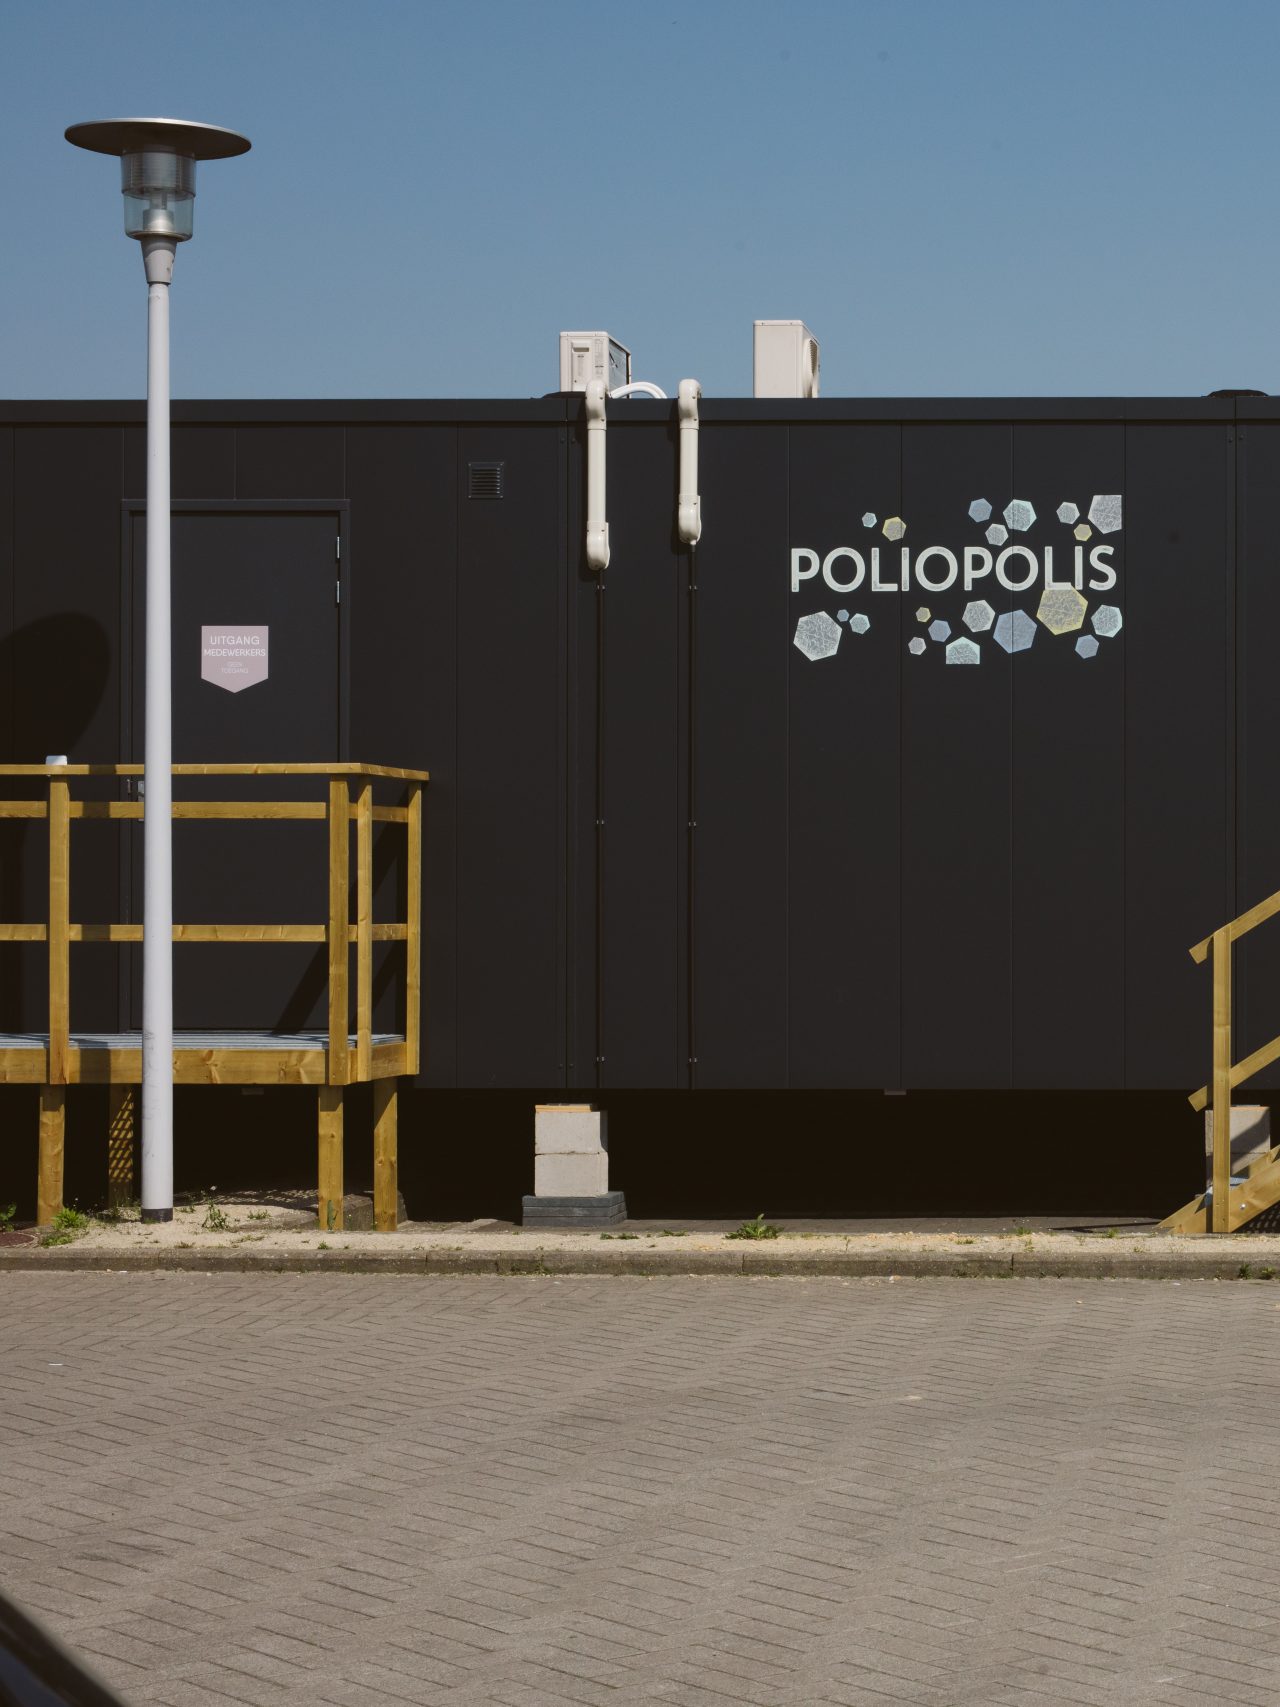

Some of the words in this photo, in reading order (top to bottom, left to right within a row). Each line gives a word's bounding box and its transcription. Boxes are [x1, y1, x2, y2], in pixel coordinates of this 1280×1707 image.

[791, 545, 1117, 593] POLIOPOLIS
[210, 635, 260, 645] UITGANG
[204, 648, 266, 657] MEDEWERKERS
